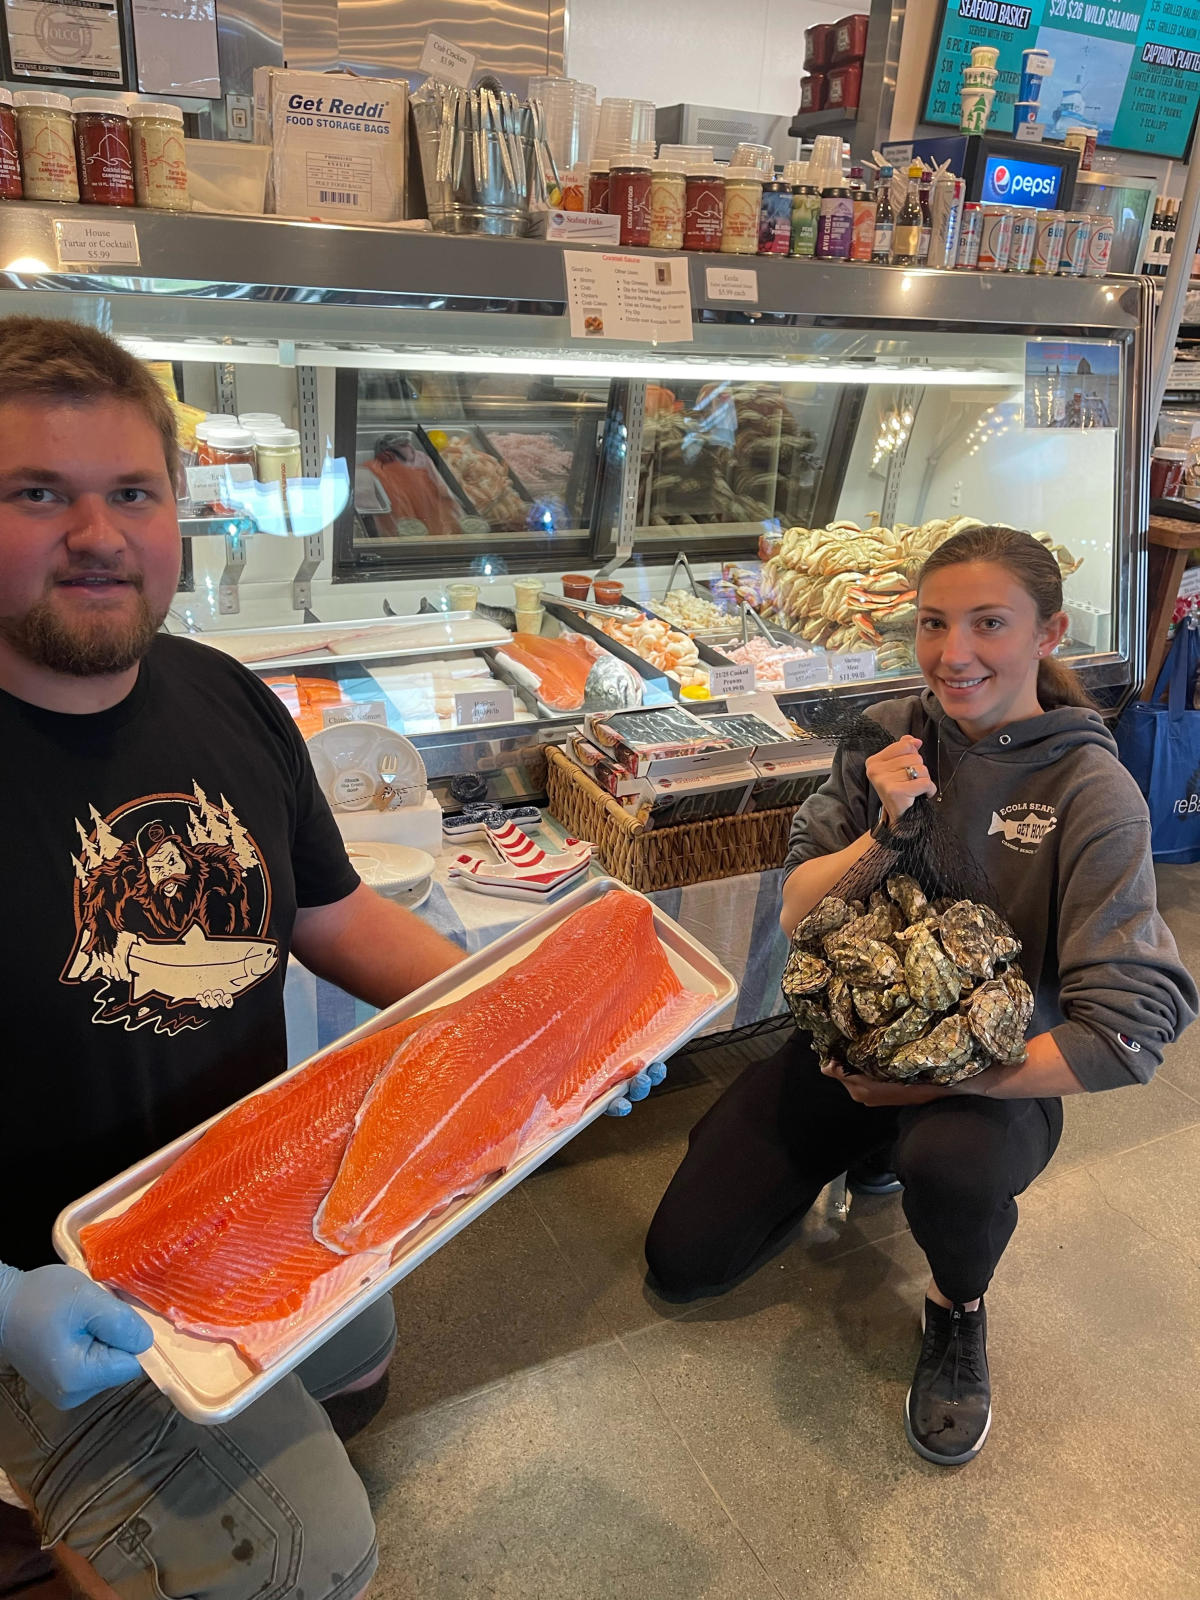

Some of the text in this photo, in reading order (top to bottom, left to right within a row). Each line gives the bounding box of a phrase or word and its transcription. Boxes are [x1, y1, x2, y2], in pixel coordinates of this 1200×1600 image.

[960, 0, 1032, 29] SEAFOOD BASKET
[1049, 0, 1140, 33] $20 $26 WILD SALMON
[1142, 43, 1178, 67] CAPTAINS
[288, 94, 386, 119] Get Reddi
[286, 115, 390, 135] FOOD STORAGE BAGS
[1011, 175, 1056, 197] pepsi
[566, 215, 588, 225] Seafood
[85, 228, 111, 238] House
[63, 239, 133, 250] Tartar or Cocktail
[822, 235, 830, 251] AVID
[87, 250, 111, 260] $5.99
[729, 667, 749, 676] Cooked
[1000, 802, 1028, 816] ECOLA
[1017, 823, 1030, 838] GET
